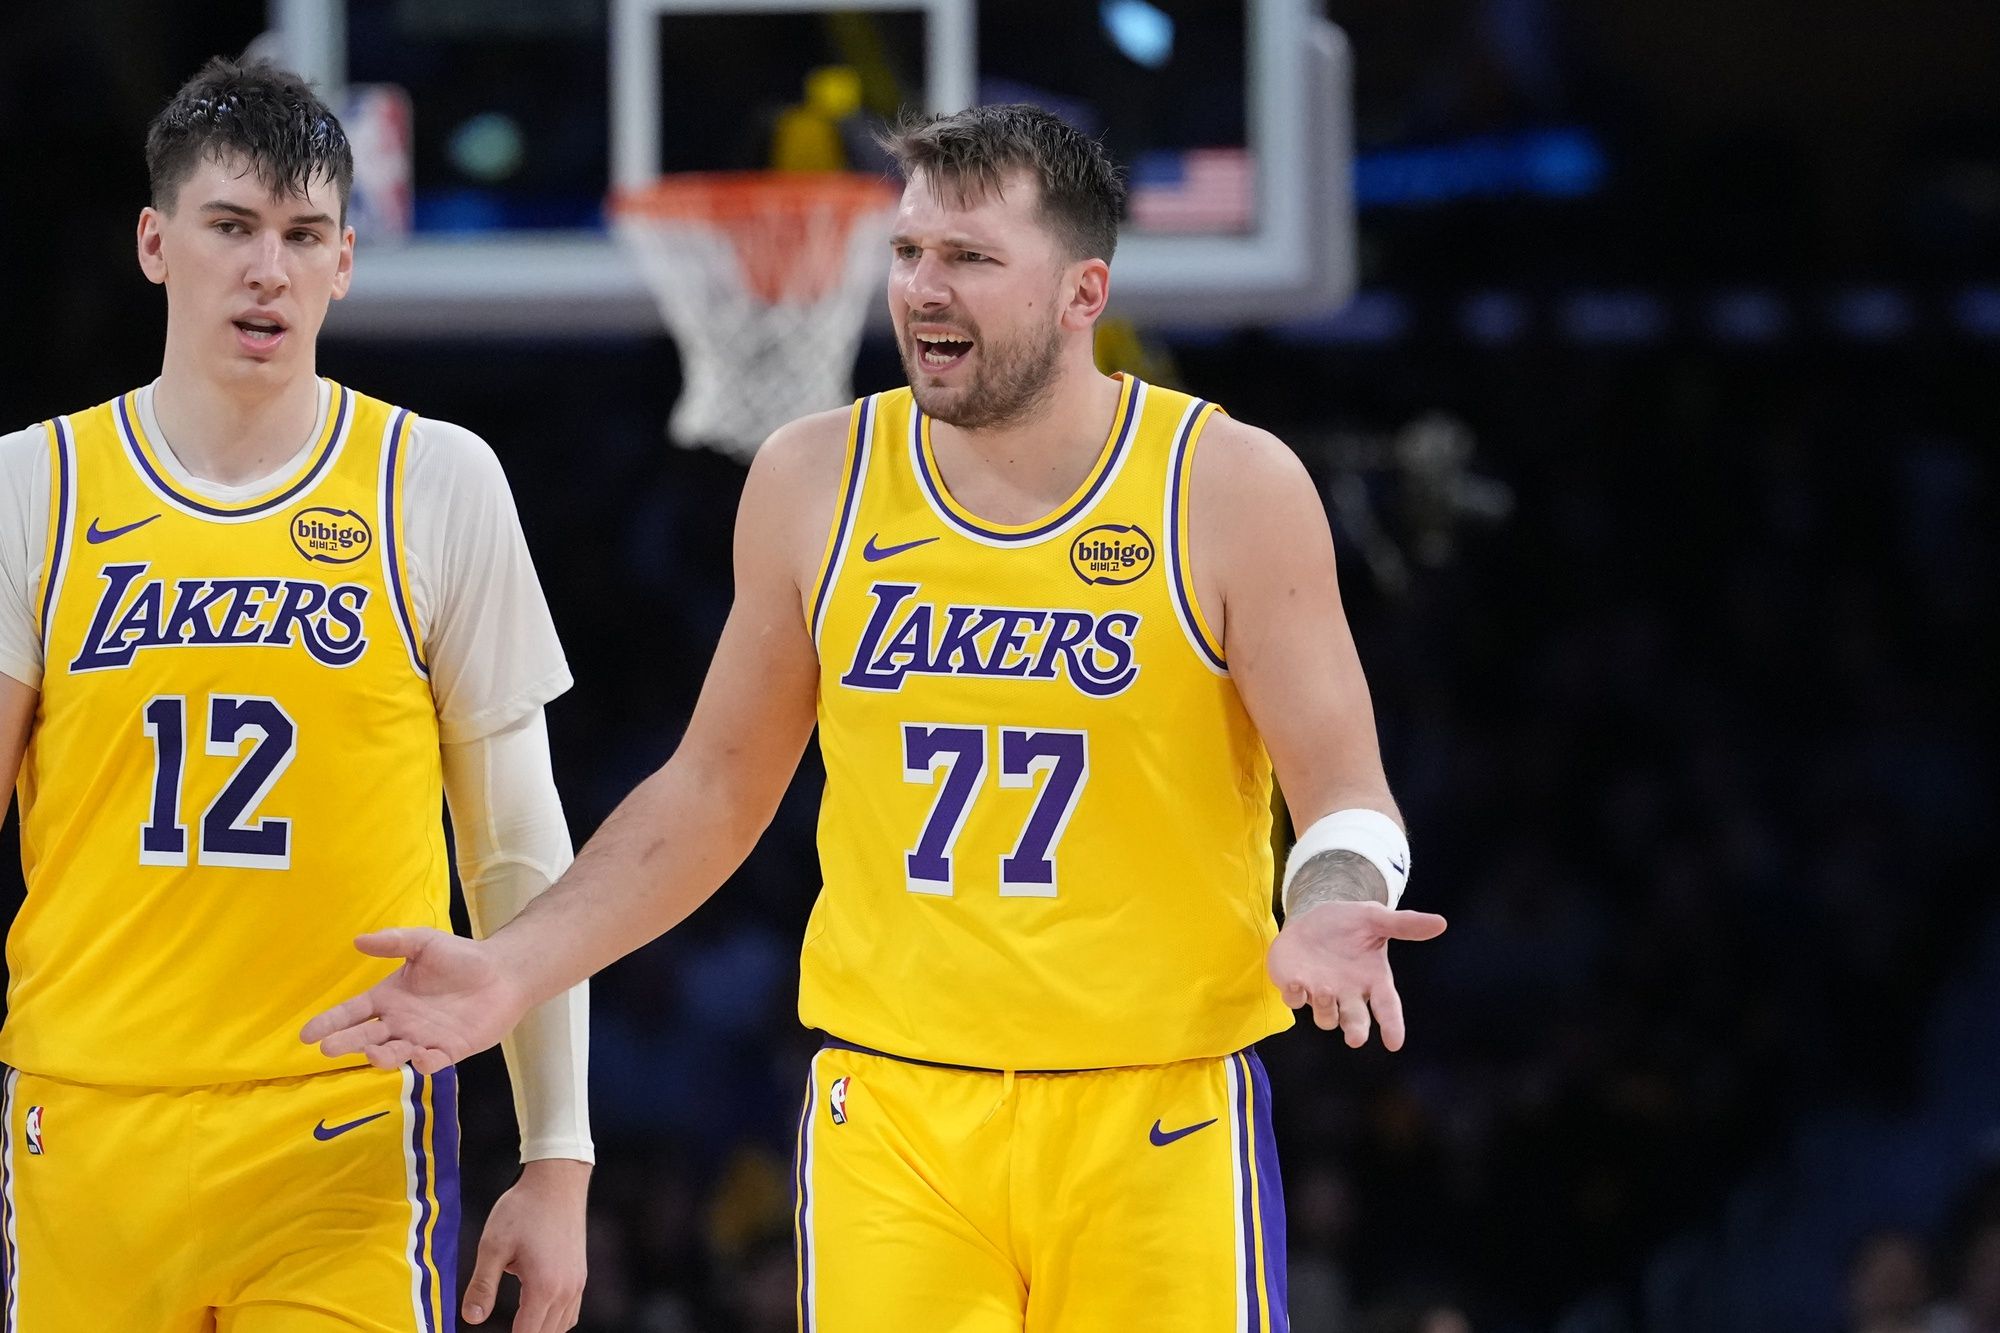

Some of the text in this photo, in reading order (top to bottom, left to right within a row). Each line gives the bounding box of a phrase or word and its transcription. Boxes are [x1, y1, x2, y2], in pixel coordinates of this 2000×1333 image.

[298, 520, 366, 548] bibigo
[309, 540, 338, 551] 비비고
[1078, 540, 1150, 567] bibigo
[1090, 562, 1119, 572] 비비고
[68, 561, 372, 674] LAKERS
[840, 580, 1142, 699] LAKERS
[139, 693, 298, 870] 12
[900, 722, 1089, 897] 77
